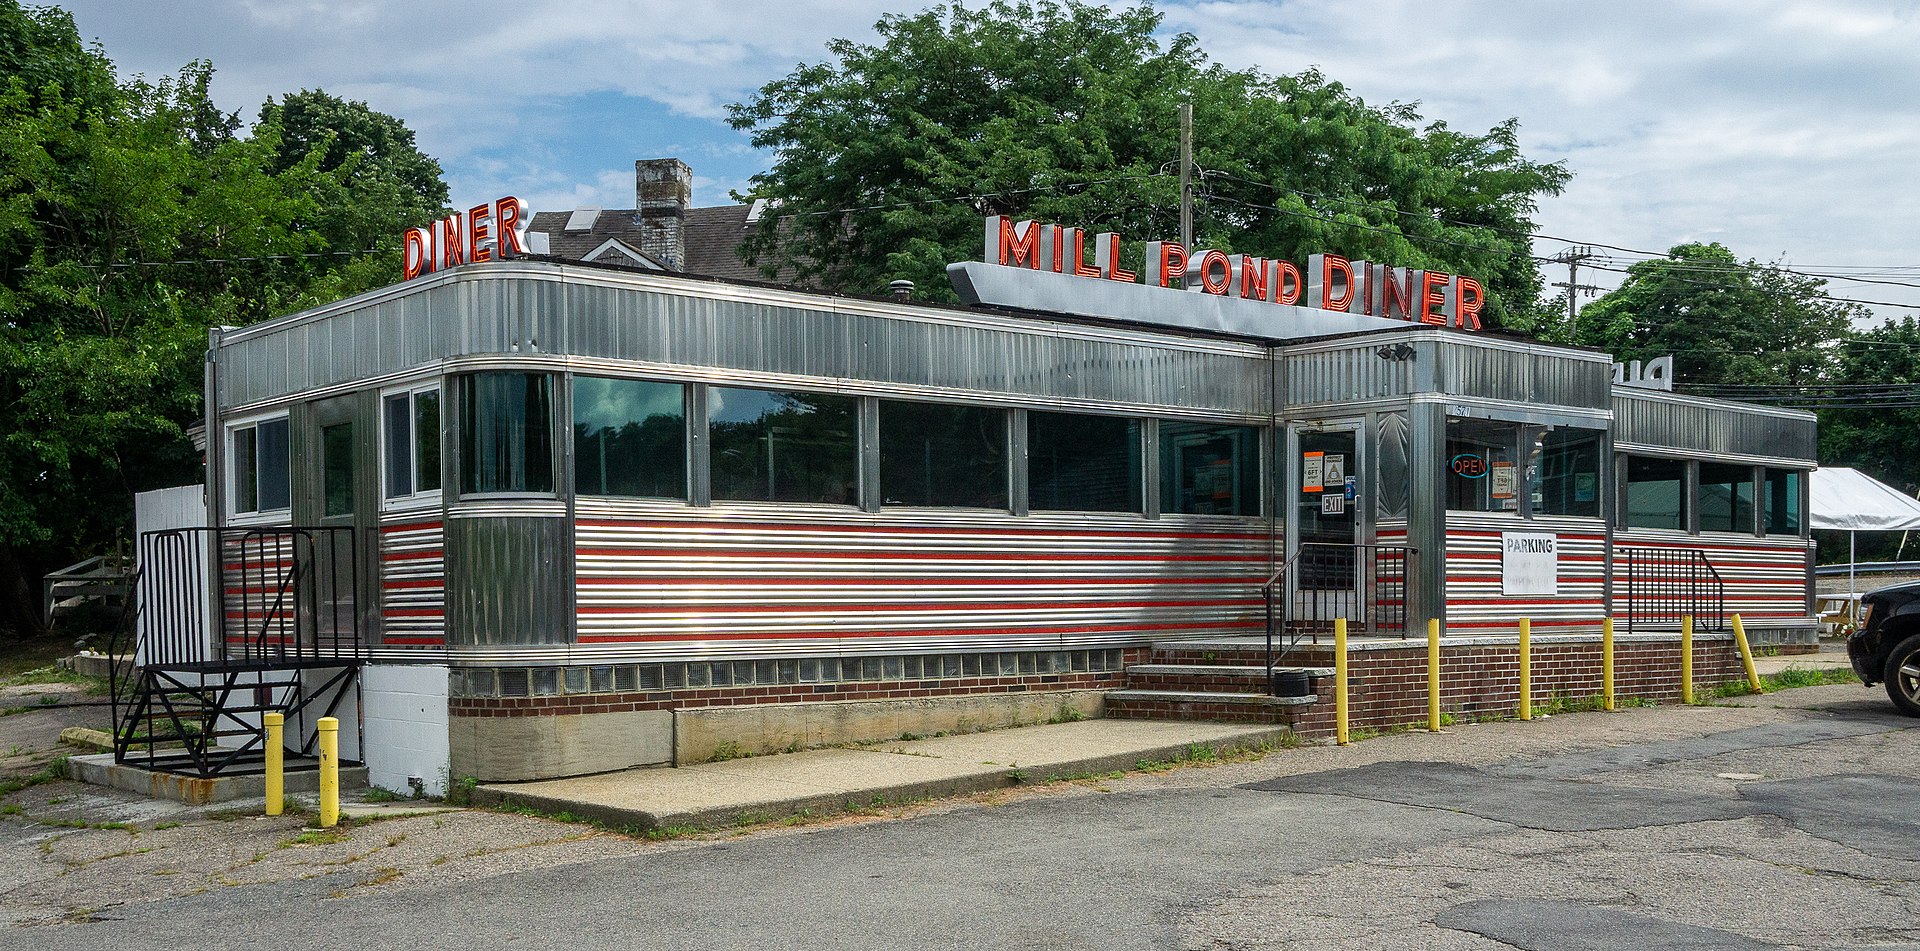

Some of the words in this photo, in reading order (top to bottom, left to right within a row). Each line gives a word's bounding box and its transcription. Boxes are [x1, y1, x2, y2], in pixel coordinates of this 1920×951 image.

[404, 196, 521, 280] DINER
[997, 215, 1136, 283] MILL
[1158, 240, 1303, 306] POND
[1321, 253, 1485, 331] DINER
[1453, 460, 1487, 474] OPEN
[1324, 497, 1343, 512] EXIT
[1507, 538, 1553, 553] PARKING
